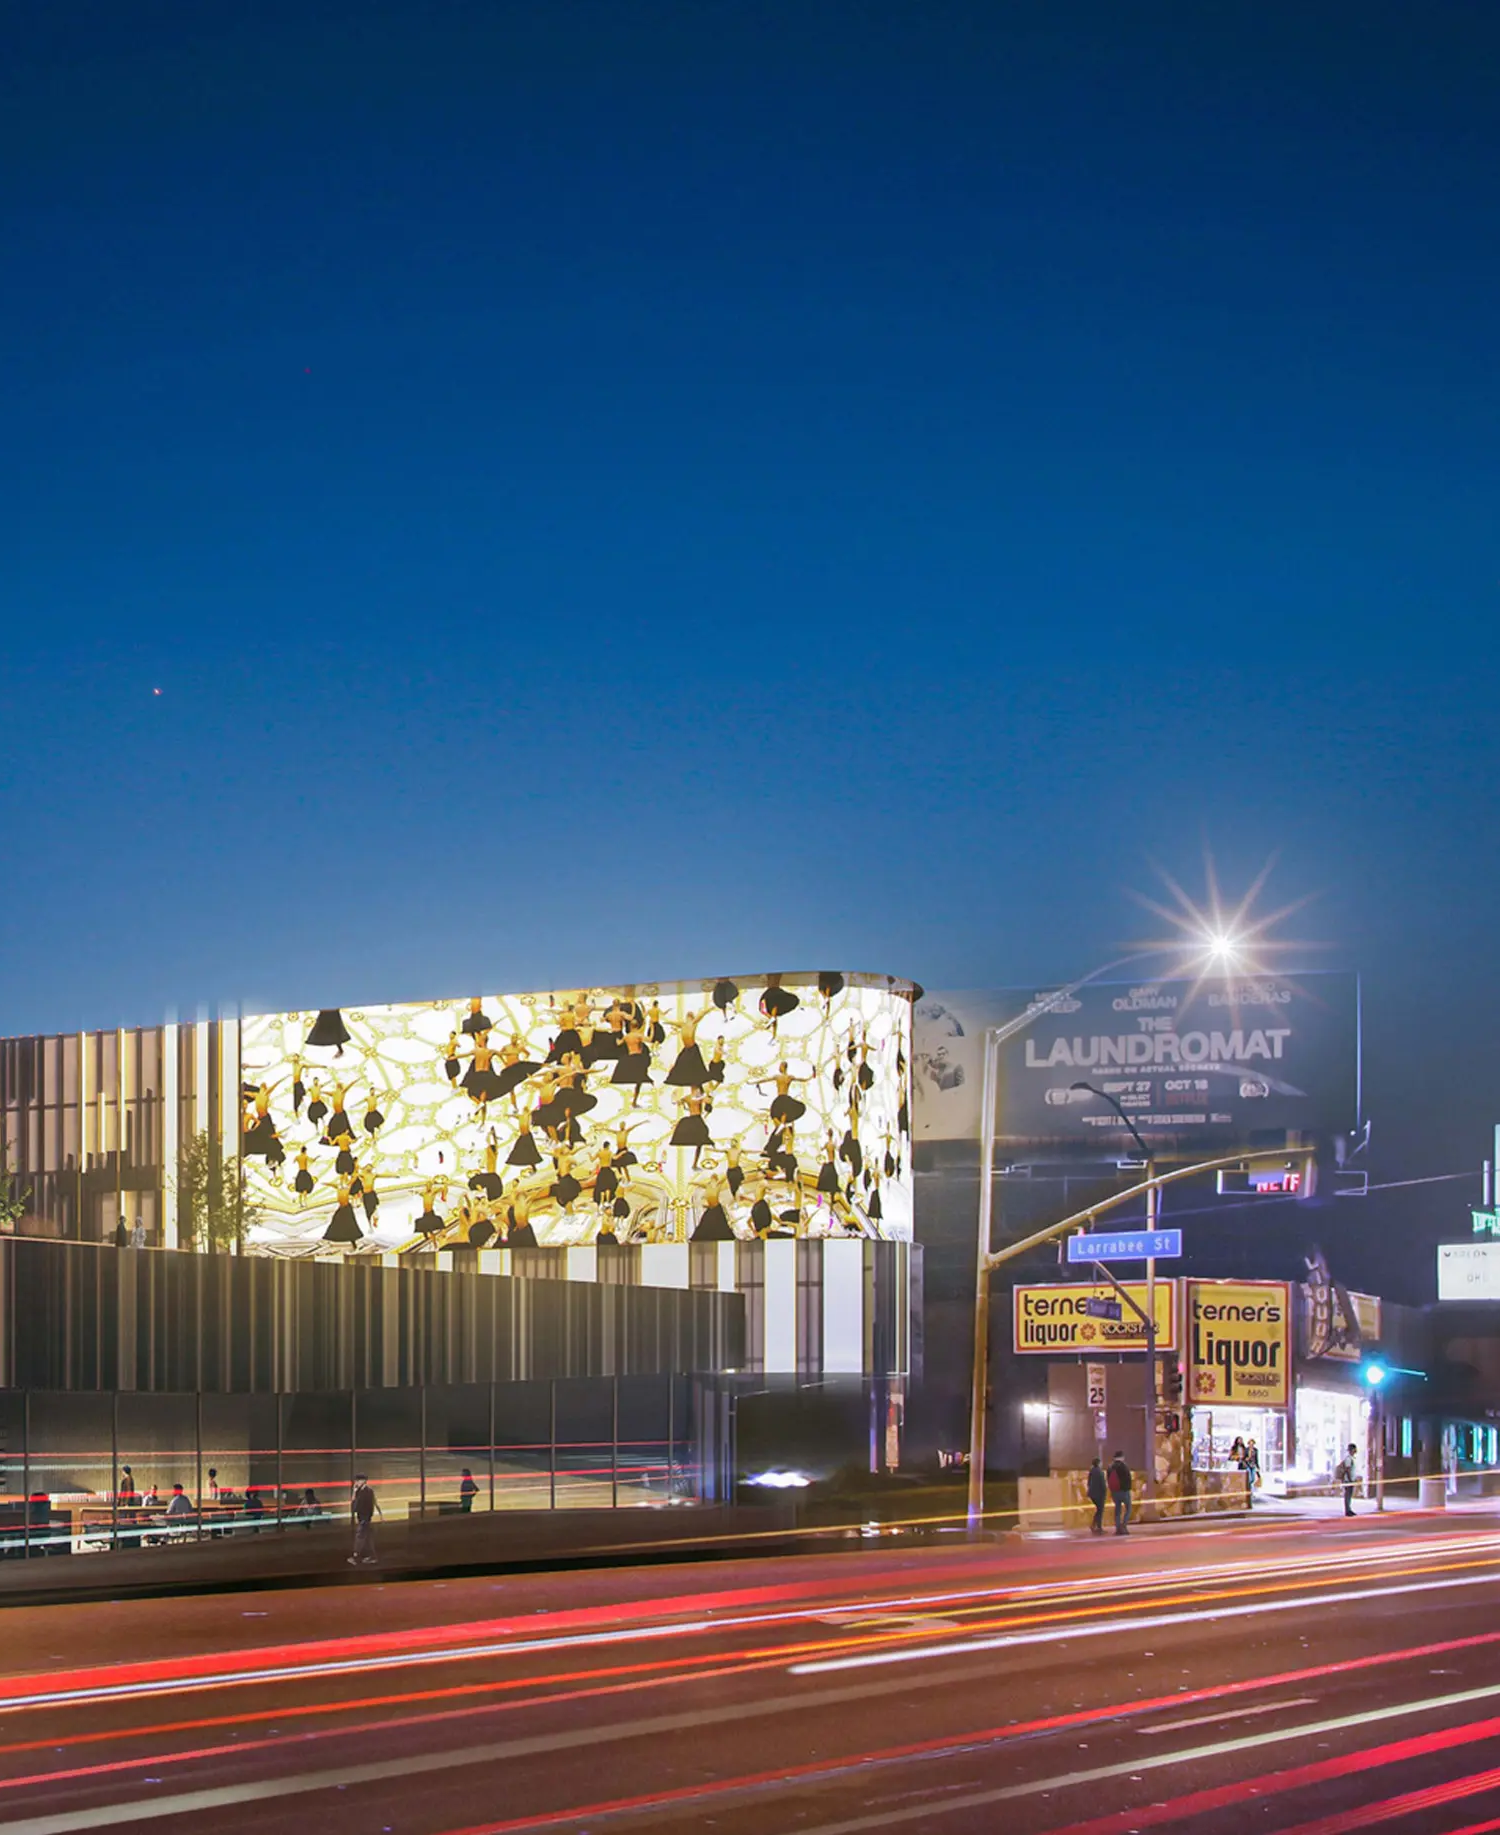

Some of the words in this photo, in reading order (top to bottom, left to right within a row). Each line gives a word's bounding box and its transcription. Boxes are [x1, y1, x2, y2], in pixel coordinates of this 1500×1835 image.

[1112, 997, 1177, 1011] OLDMAN
[1137, 1016, 1173, 1031] THE
[1025, 1029, 1291, 1067] LAUNDROMAT
[1136, 1081, 1151, 1091] 27
[1164, 1080, 1191, 1091] OCT
[1077, 1240, 1144, 1255] Larrabee
[1154, 1237, 1171, 1251] St
[1193, 1300, 1281, 1322] terner's
[1024, 1319, 1078, 1345] liquor
[1101, 1322, 1161, 1336] ROCKSTR
[1193, 1323, 1281, 1396] Liquor
[1090, 1387, 1105, 1404] 25
